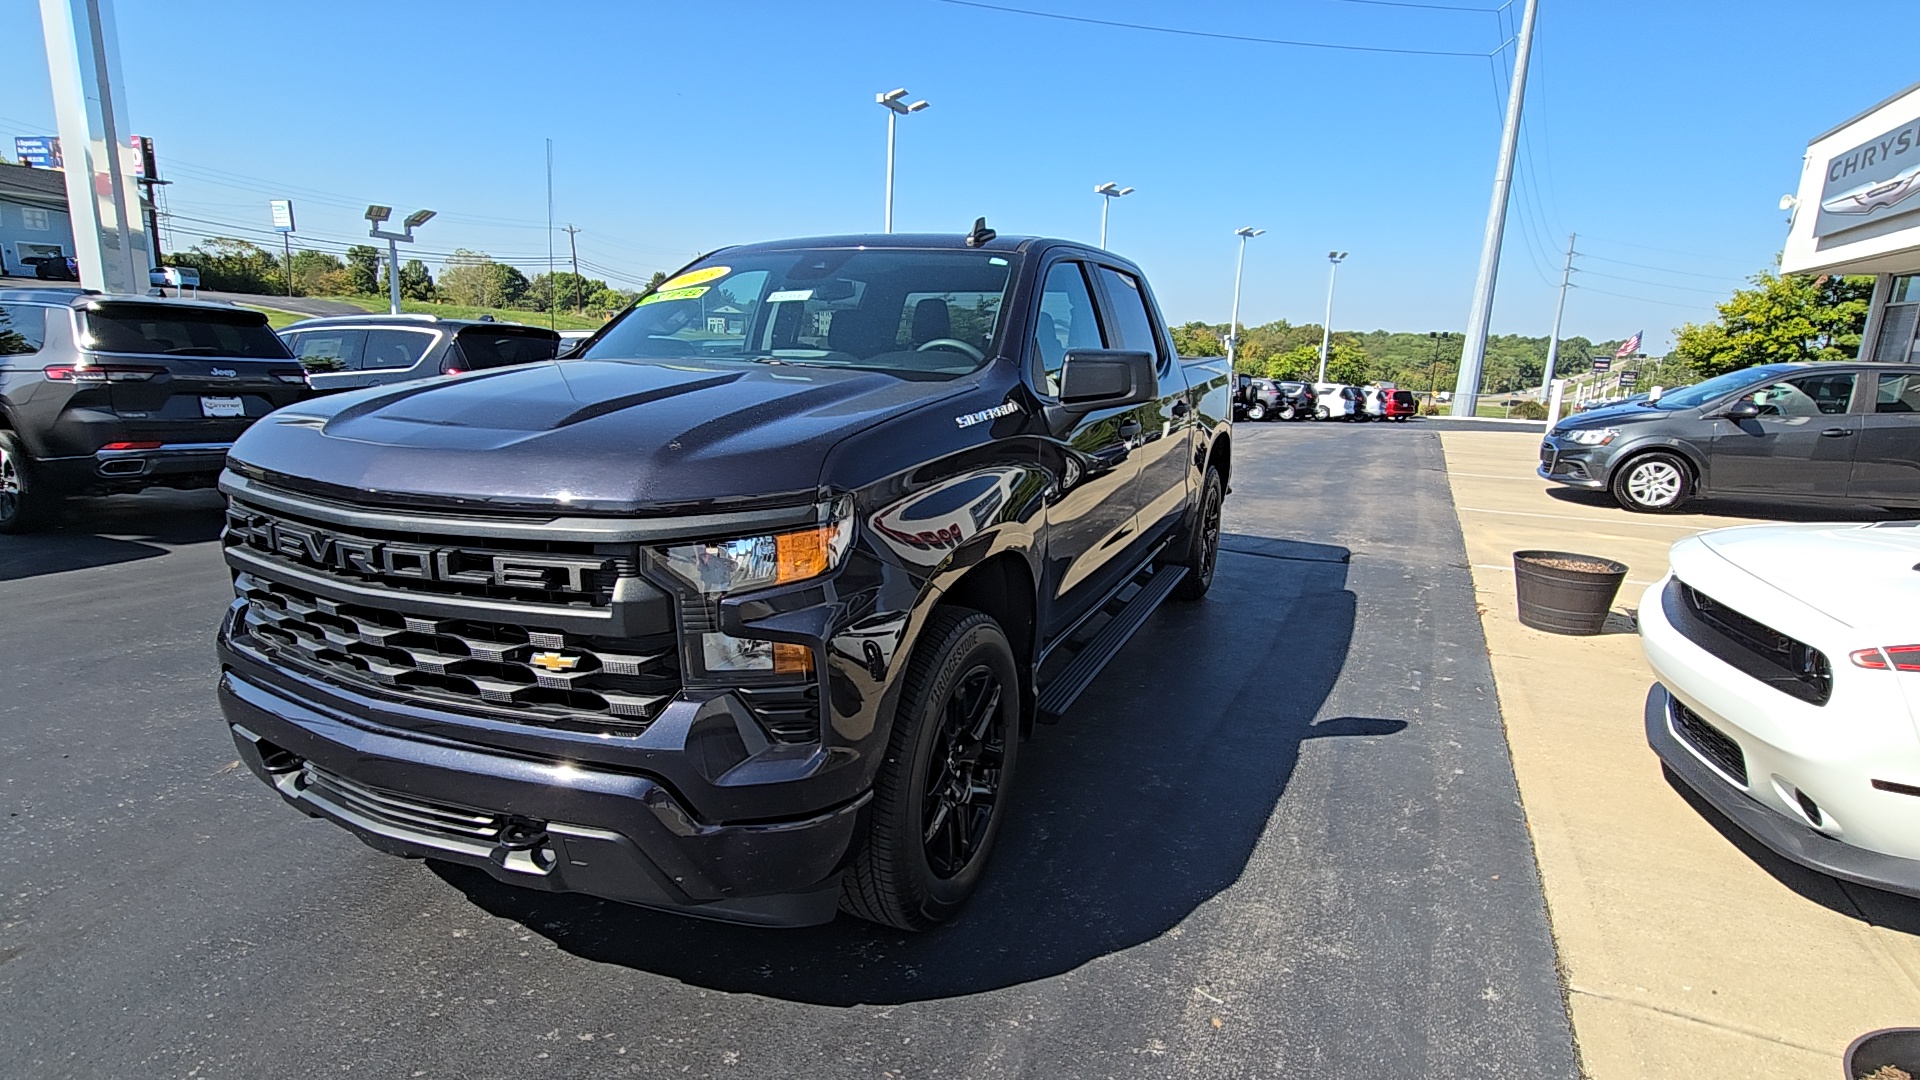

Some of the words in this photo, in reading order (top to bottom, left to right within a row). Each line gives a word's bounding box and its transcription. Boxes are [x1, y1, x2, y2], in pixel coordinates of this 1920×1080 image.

[210, 367, 237, 378] Jeep
[955, 402, 1018, 429] SILVERADO
[225, 507, 610, 592] CHEVROLET
[931, 631, 979, 708] BRIDGESTONE
